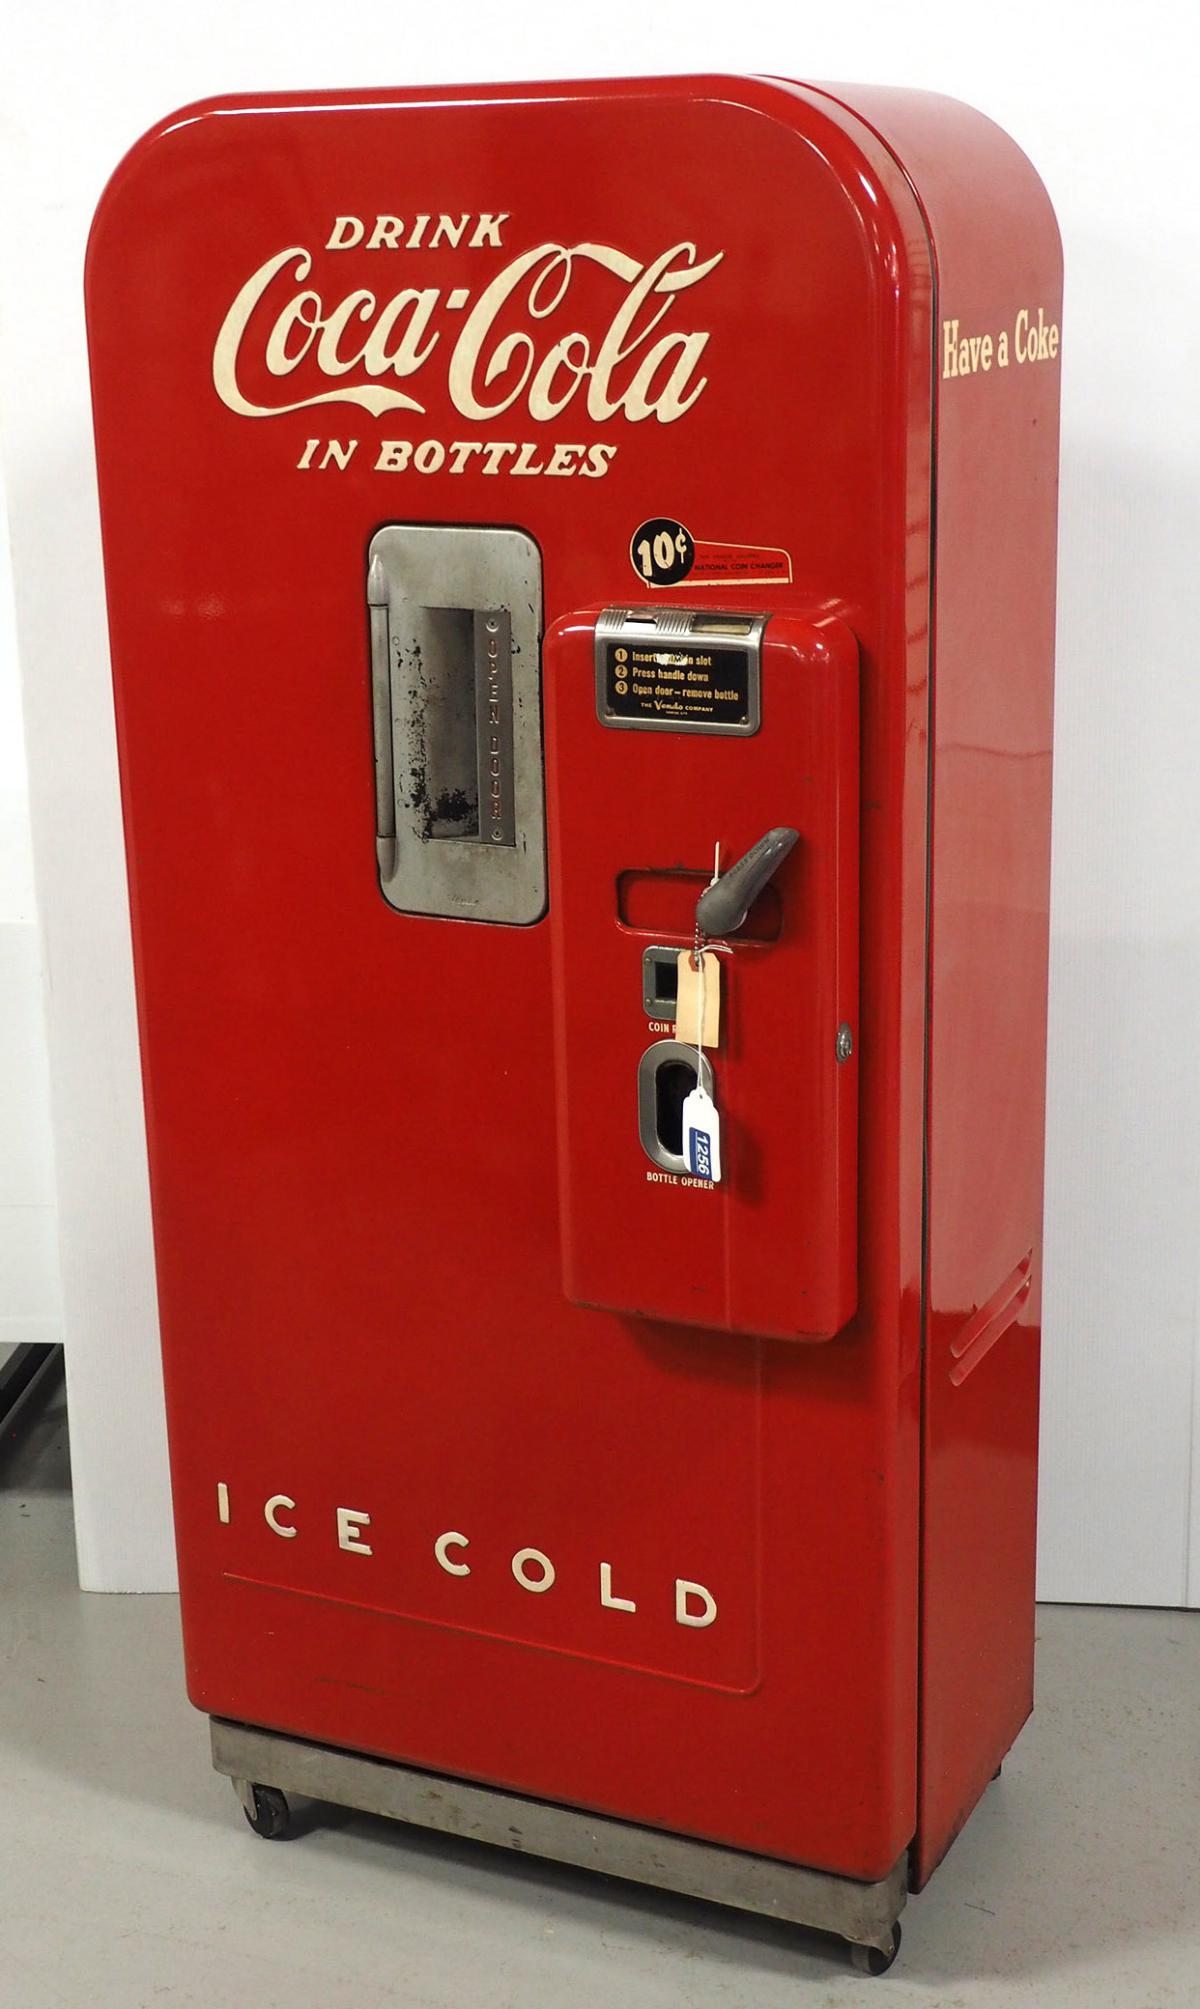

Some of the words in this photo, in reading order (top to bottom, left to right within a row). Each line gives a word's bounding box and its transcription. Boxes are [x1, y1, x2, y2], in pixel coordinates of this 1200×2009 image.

[325, 212, 511, 250] DRINK
[212, 241, 725, 423] Coca-Cola
[943, 319, 993, 379] Have
[997, 331, 1009, 367] a
[1014, 307, 1059, 363] Coke
[296, 439, 359, 471] IN
[374, 440, 618, 478] BOTTLES
[637, 528, 688, 577] 10¢
[695, 563, 728, 571] NATIONAL
[632, 651, 657, 662] Insert
[696, 655, 712, 666] slot
[632, 667, 656, 679] Press
[658, 668, 685, 681] handle
[687, 671, 709, 682] down
[632, 683, 653, 696] Open
[714, 689, 739, 701] bottle
[653, 700, 684, 711] Vendo
[685, 704, 714, 713] COMPANY
[648, 1021, 670, 1033] COIN
[697, 1135, 710, 1175] 1256
[646, 1171, 678, 1185] BOTTLE
[681, 1176, 715, 1190] OPENER
[217, 1482, 373, 1555] ICE
[434, 1531, 717, 1628] COLD
